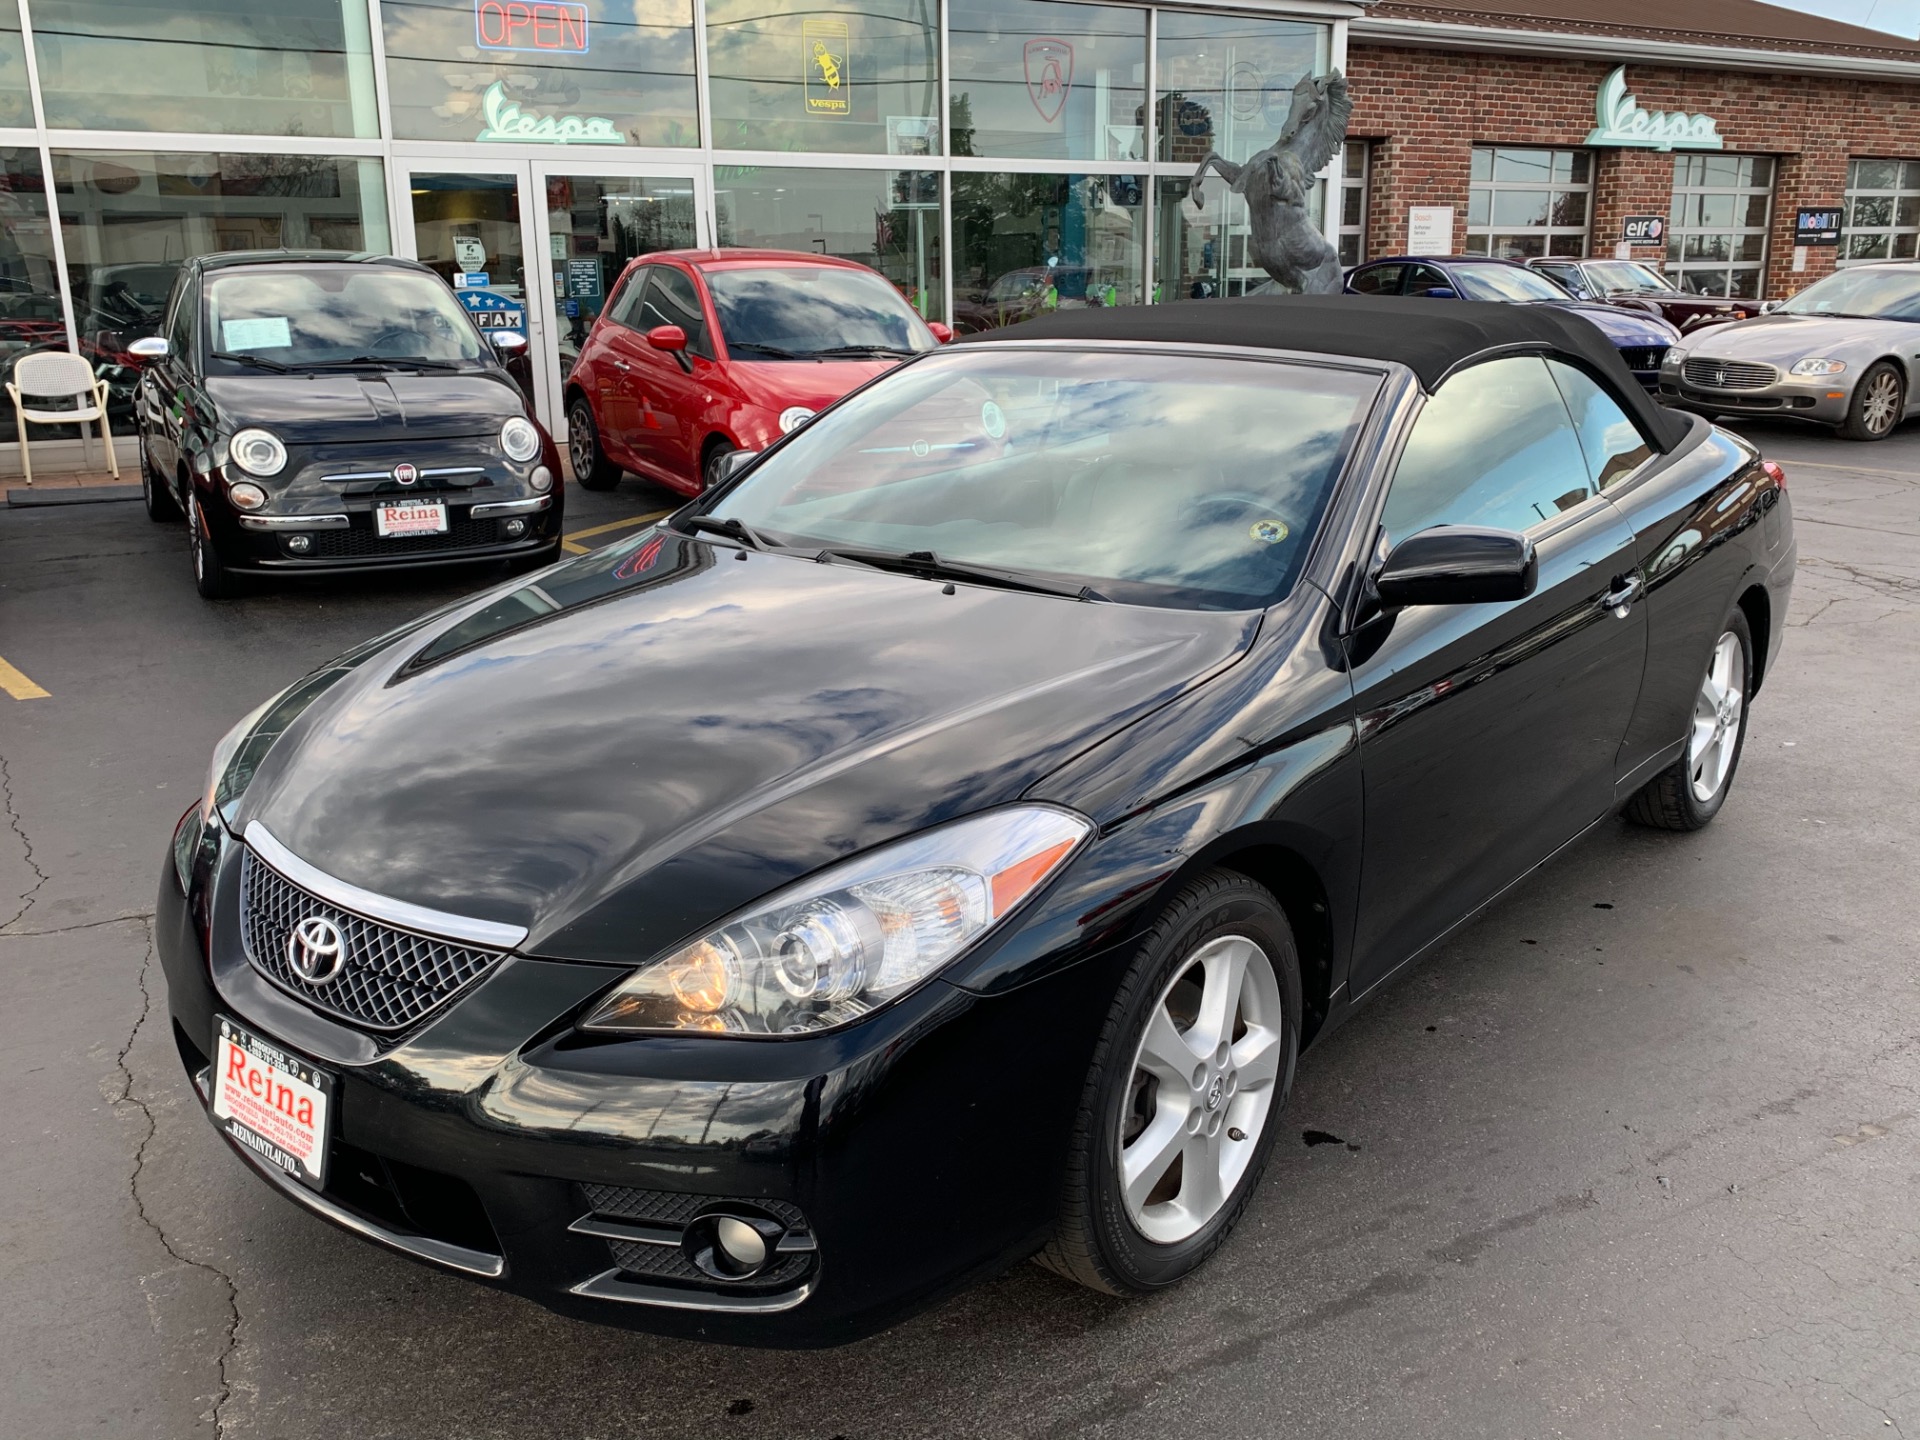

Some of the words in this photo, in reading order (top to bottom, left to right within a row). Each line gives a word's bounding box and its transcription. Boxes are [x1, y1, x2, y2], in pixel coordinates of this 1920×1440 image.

[480, 1, 585, 49] OPEN
[476, 80, 626, 144] Vespa
[809, 98, 847, 110] Vespa
[1584, 64, 1723, 151] Vespa
[1626, 221, 1650, 237] elf
[1799, 212, 1829, 229] Mobil
[384, 507, 440, 522] Reina
[250, 1037, 285, 1062] BROOKFIELD
[227, 1043, 315, 1130] Reina
[257, 1122, 276, 1139] SPORTS
